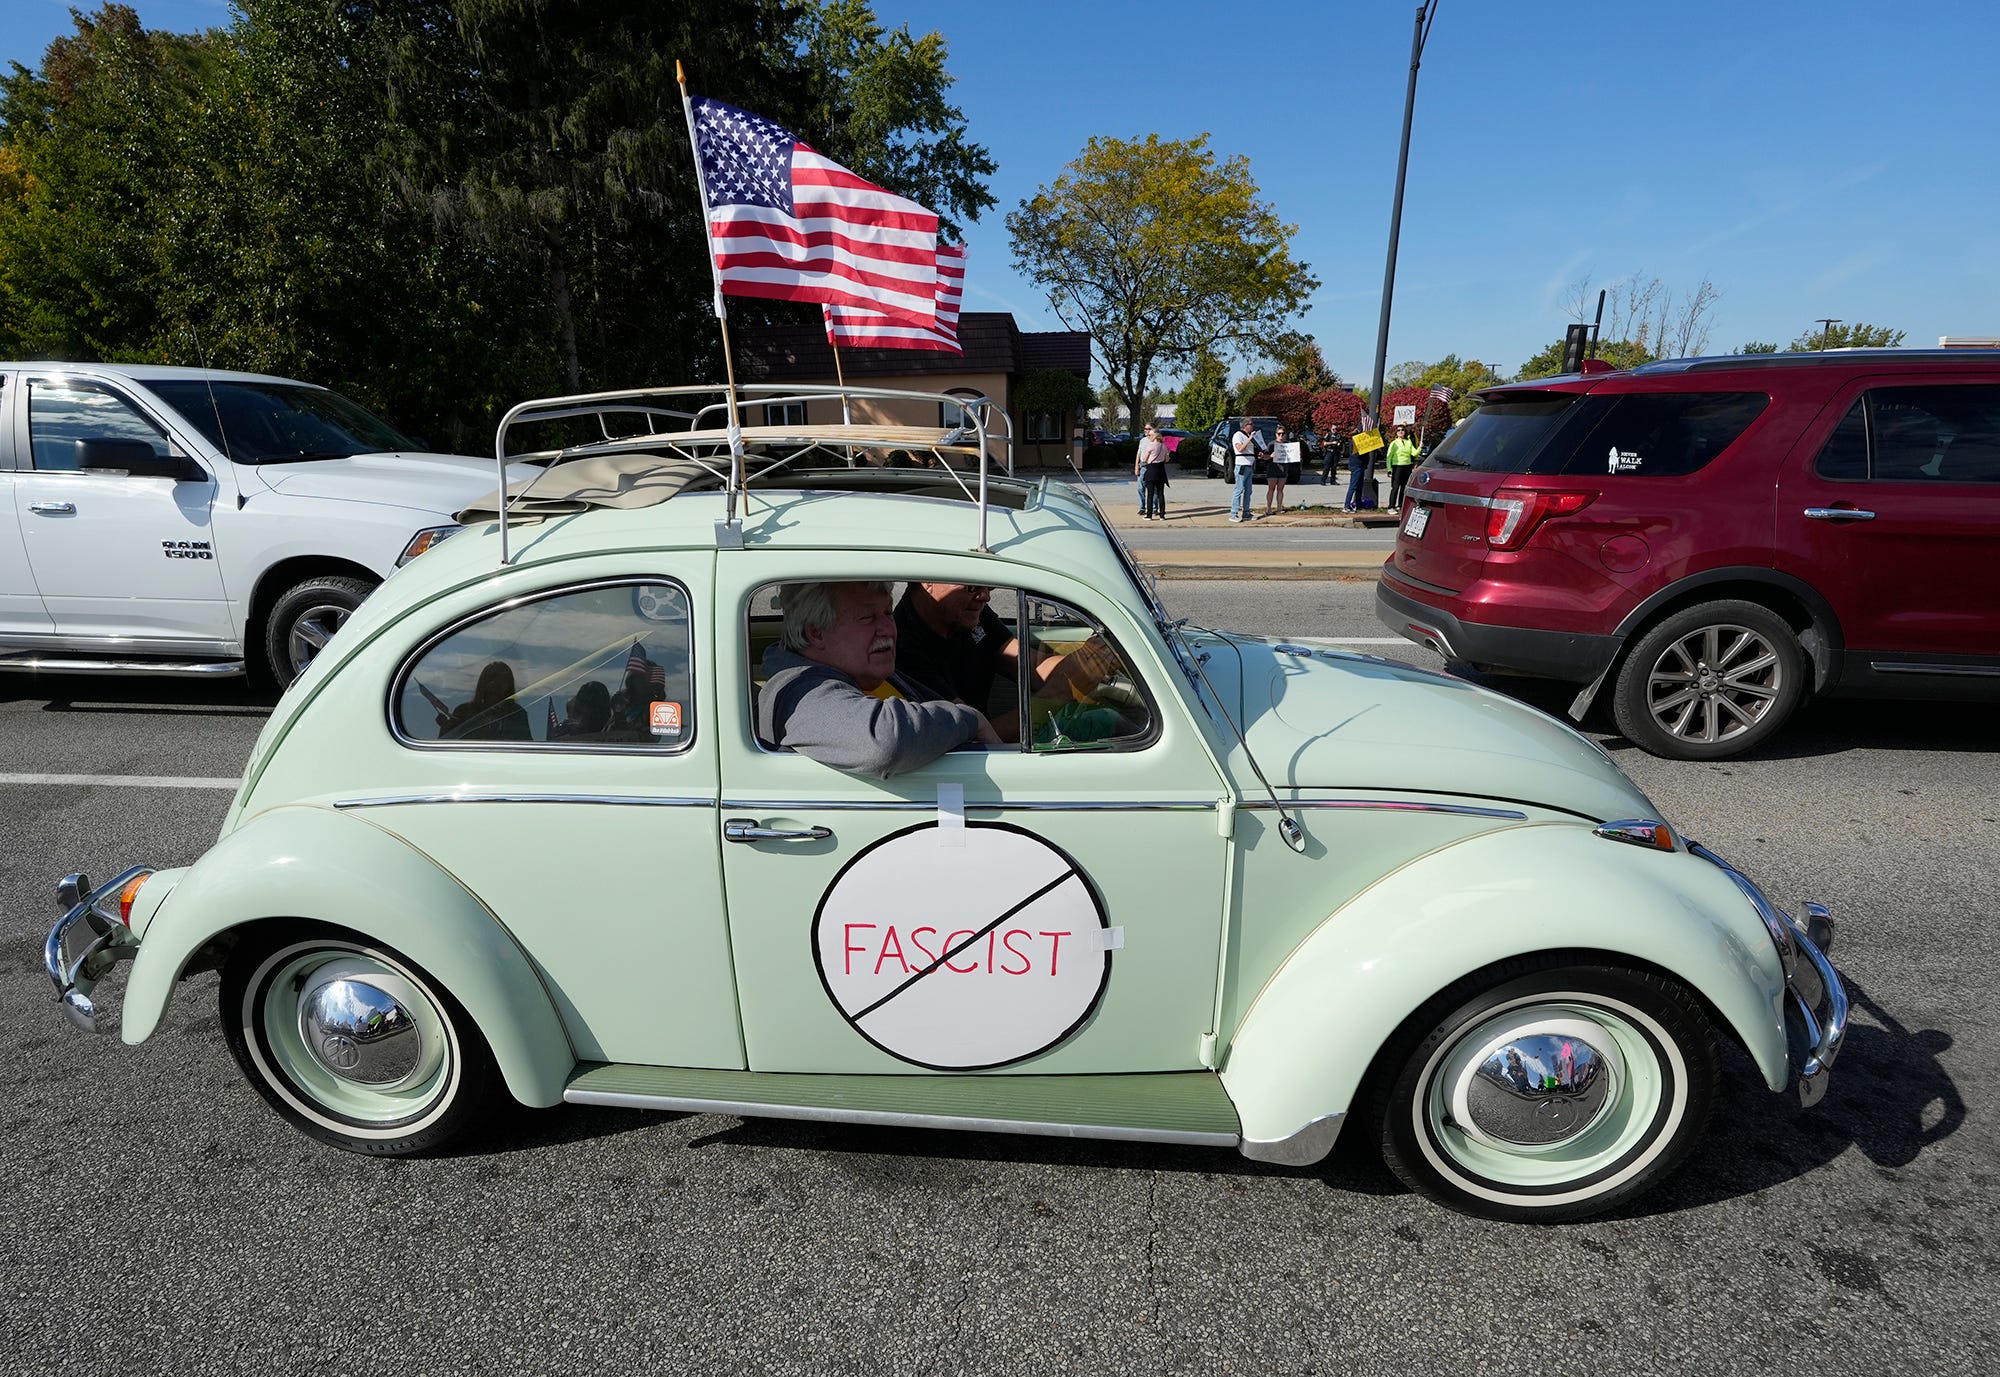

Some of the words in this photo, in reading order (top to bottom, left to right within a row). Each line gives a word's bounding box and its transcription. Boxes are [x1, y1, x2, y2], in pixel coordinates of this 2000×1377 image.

[1620, 457, 1642, 465] WALK
[161, 539, 211, 550] RAM
[163, 550, 212, 559] 1500
[842, 922, 1072, 977] FASCIST
